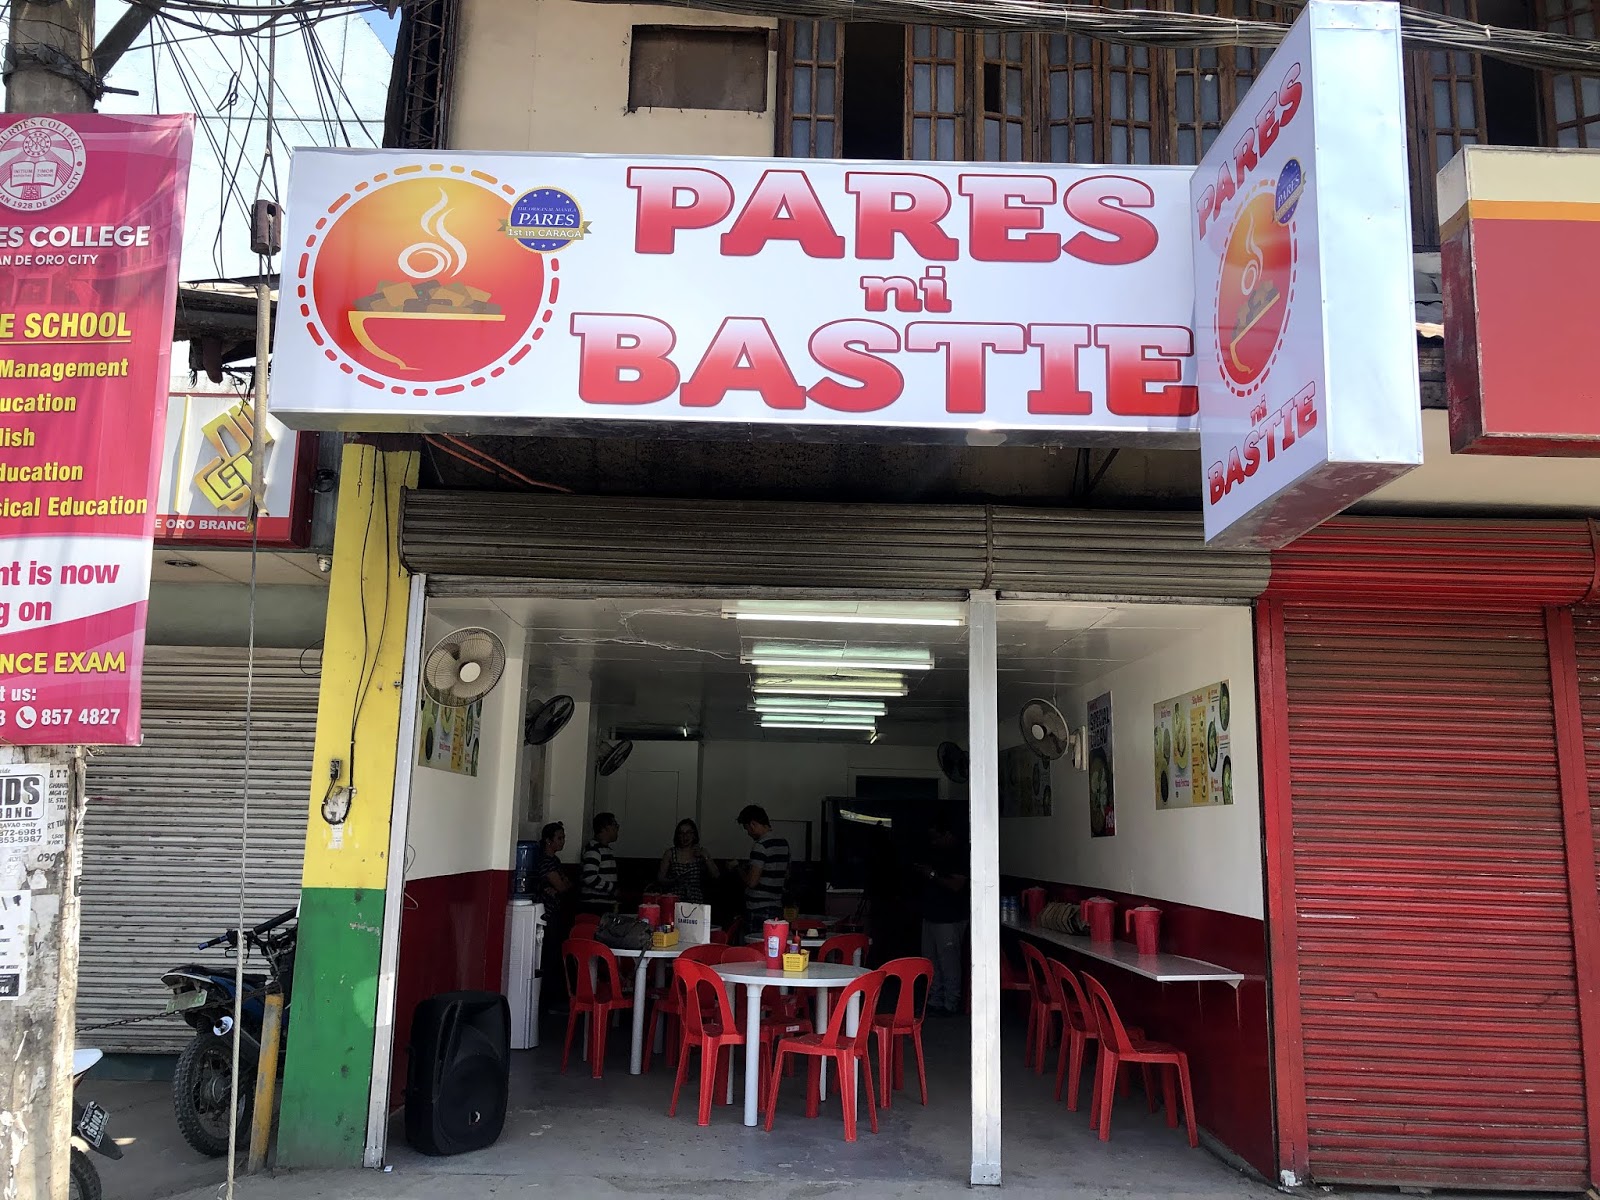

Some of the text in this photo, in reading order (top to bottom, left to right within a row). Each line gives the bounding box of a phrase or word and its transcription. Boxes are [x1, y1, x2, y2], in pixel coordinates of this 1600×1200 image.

[39, 118, 83, 153] COLLEGE
[1196, 61, 1303, 241] PARES
[12, 200, 33, 209] 1928
[36, 200, 48, 209] DE
[49, 190, 68, 203] ORO
[67, 170, 82, 190] CITY
[517, 212, 575, 227] PARES
[626, 166, 1160, 266] PARES
[29, 226, 151, 248] COLLEGE
[508, 228, 582, 238] 1st in CARAGA
[15, 254, 32, 266] DE
[35, 254, 65, 266] ORO
[68, 254, 99, 266] CITY
[859, 265, 953, 313] ni
[23, 312, 132, 338] SCHOOL
[0, 358, 129, 382] Management
[570, 312, 1200, 417] BASTIE
[1250, 394, 1268, 428] ni
[1207, 380, 1318, 506] BASTIE
[0, 495, 148, 517] ical Education
[165, 518, 195, 530] ORO
[198, 519, 250, 532] BRANC
[28, 560, 53, 586] is
[60, 564, 121, 585] now
[19, 601, 53, 622] on
[0, 651, 126, 674] NCE EXAM
[11, 687, 37, 702] us:
[40, 708, 73, 725] 857
[78, 708, 121, 725] 4827
[0, 776, 40, 805] DS
